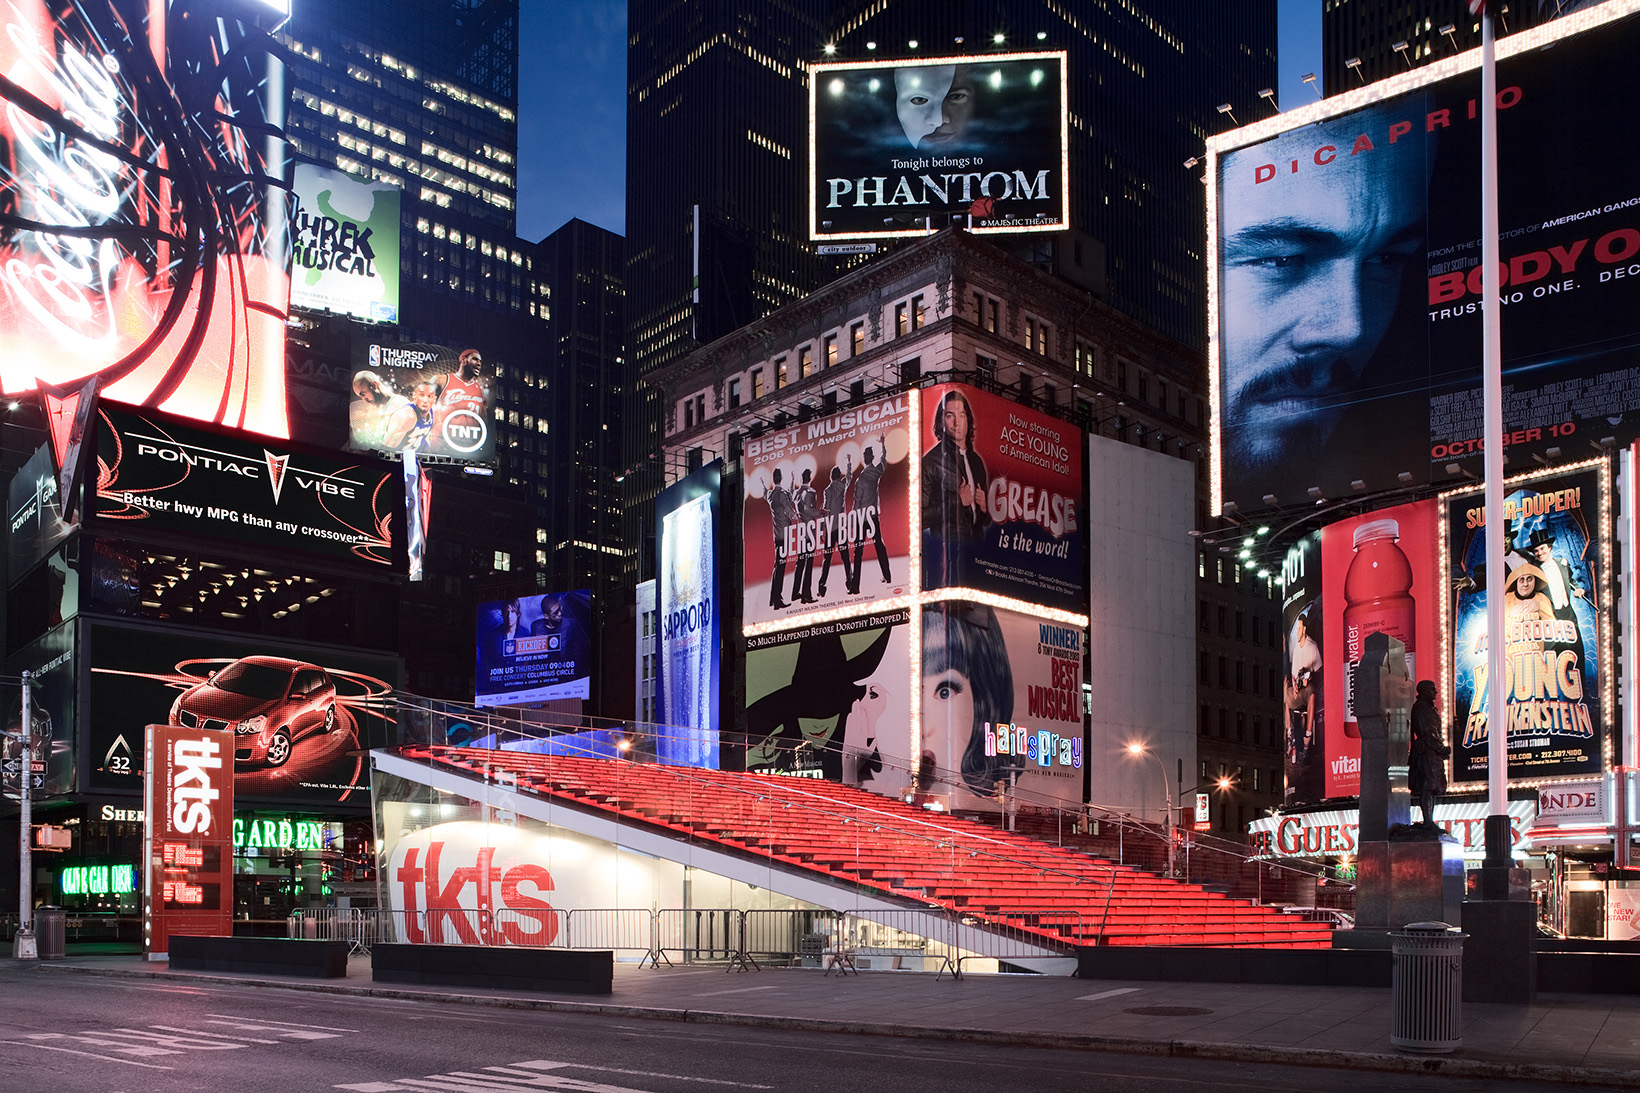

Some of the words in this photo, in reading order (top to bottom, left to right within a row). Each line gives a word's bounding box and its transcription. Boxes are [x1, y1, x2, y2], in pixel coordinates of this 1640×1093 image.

[1255, 86, 1523, 185] DICAPRIO
[891, 158, 929, 171] Tonight
[932, 156, 970, 169] belongs
[973, 156, 983, 165] to
[826, 169, 1050, 209] PHANTOM
[987, 218, 1024, 227] MAJESTIC
[1025, 217, 1058, 225] THEATRE
[1427, 248, 1455, 259] FROM
[1457, 241, 1475, 251] THE
[1527, 223, 1540, 233] OF
[1541, 208, 1601, 229] AMERICAN
[1428, 239, 1589, 306] BODY
[1432, 261, 1450, 275] RIDLEY
[1451, 256, 1467, 269] SCOTT
[1468, 257, 1478, 266] FILM
[1498, 292, 1523, 306] NO
[1533, 279, 1580, 298] ONE.
[381, 347, 438, 363] THURSDAY
[383, 358, 424, 369] NIGHTS
[1544, 383, 1564, 394] RIDLEY
[1565, 378, 1582, 389] SCOTT
[1596, 369, 1628, 384] LEONARDO
[1511, 400, 1528, 411] ISAAC
[1531, 394, 1550, 407] SIMON
[1520, 406, 1553, 419] ALEXANDER
[1595, 393, 1620, 406] MICHAEL
[1606, 403, 1627, 415] RIDLEY
[449, 425, 481, 440] TNT
[747, 430, 799, 458] BEST
[807, 396, 909, 444] MUSICAL
[1009, 413, 1028, 430] Now
[1030, 422, 1060, 443] starring
[1529, 415, 1552, 429] DONALD
[1549, 422, 1576, 438] 10
[753, 451, 785, 466] 2006
[788, 441, 814, 457] Tony
[817, 430, 856, 447] Award
[860, 416, 902, 435] Winner
[1000, 426, 1024, 446] ACE
[1027, 434, 1069, 461] YOUNG
[138, 443, 259, 479] PONTIAC
[294, 476, 356, 499] VIBE
[1000, 443, 1009, 454] of
[1010, 446, 1050, 469] American
[1052, 462, 1070, 475] Idol!
[12, 502, 36, 533] PONTIAC
[123, 492, 170, 511] Better
[174, 500, 203, 518] hwy
[207, 506, 239, 523] MPG
[242, 512, 272, 529] than
[275, 519, 298, 535] any
[988, 477, 1078, 538] GREASE
[779, 514, 834, 559] JERSEY
[838, 505, 876, 546] BOYS
[999, 529, 1009, 548] is
[1013, 532, 1031, 553] the
[1035, 541, 1069, 559] word!
[664, 598, 710, 641] SAPPORO
[1511, 620, 1577, 644] BROOKS
[518, 639, 547, 651] KICKOFF
[1038, 642, 1041, 654] 8
[1039, 623, 1079, 651] WINNER!
[49, 655, 62, 670] PONTIAC
[63, 650, 71, 662] VIBE
[515, 664, 549, 672] THURSDAY
[527, 670, 555, 678] COLUMBUS
[556, 668, 575, 676] CIRCLE
[1051, 657, 1079, 693] BEST
[1028, 684, 1080, 723] MUSICAL
[1463, 699, 1594, 748] FRKENSTEIN
[984, 721, 1082, 768] hairspray
[112, 756, 130, 770] 32
[173, 737, 222, 834] tkts
[233, 818, 323, 849] GARDEN
[1277, 816, 1359, 854] GUES
[62, 866, 88, 895] OLIVE
[89, 864, 133, 894] GARDEN
[397, 841, 559, 946] tkts
